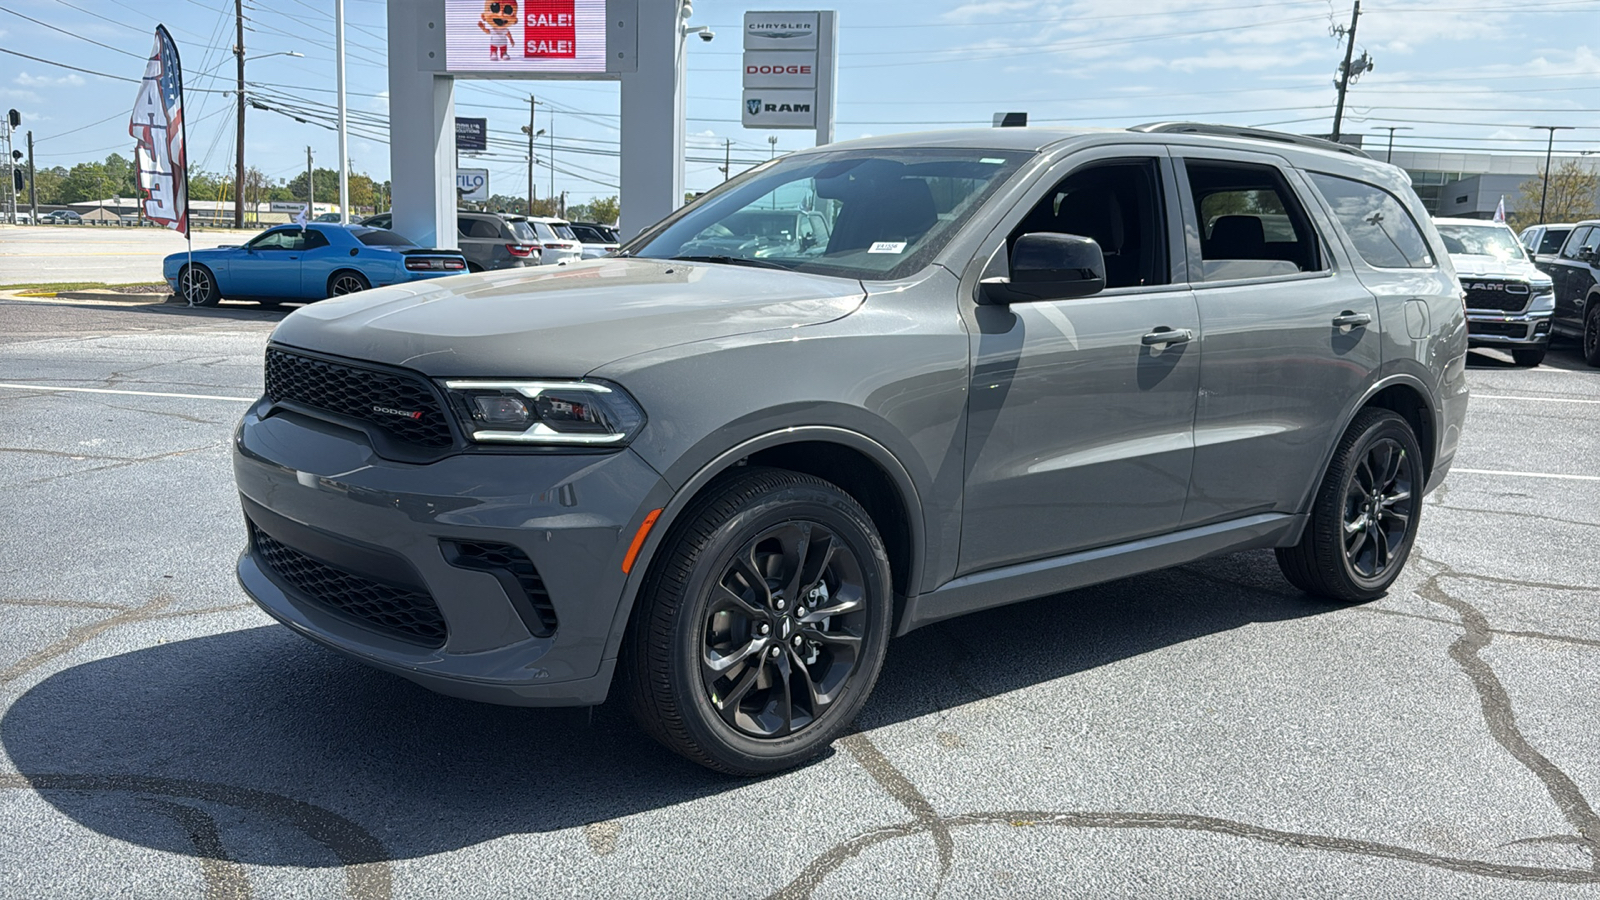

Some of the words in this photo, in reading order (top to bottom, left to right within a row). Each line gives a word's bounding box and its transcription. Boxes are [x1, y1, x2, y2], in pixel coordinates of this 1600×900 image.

[527, 13, 573, 27] SALE!
[527, 39, 573, 53] SALE!
[746, 65, 811, 75] DODGE
[764, 103, 810, 113] RAM
[373, 405, 415, 418] DODGE
